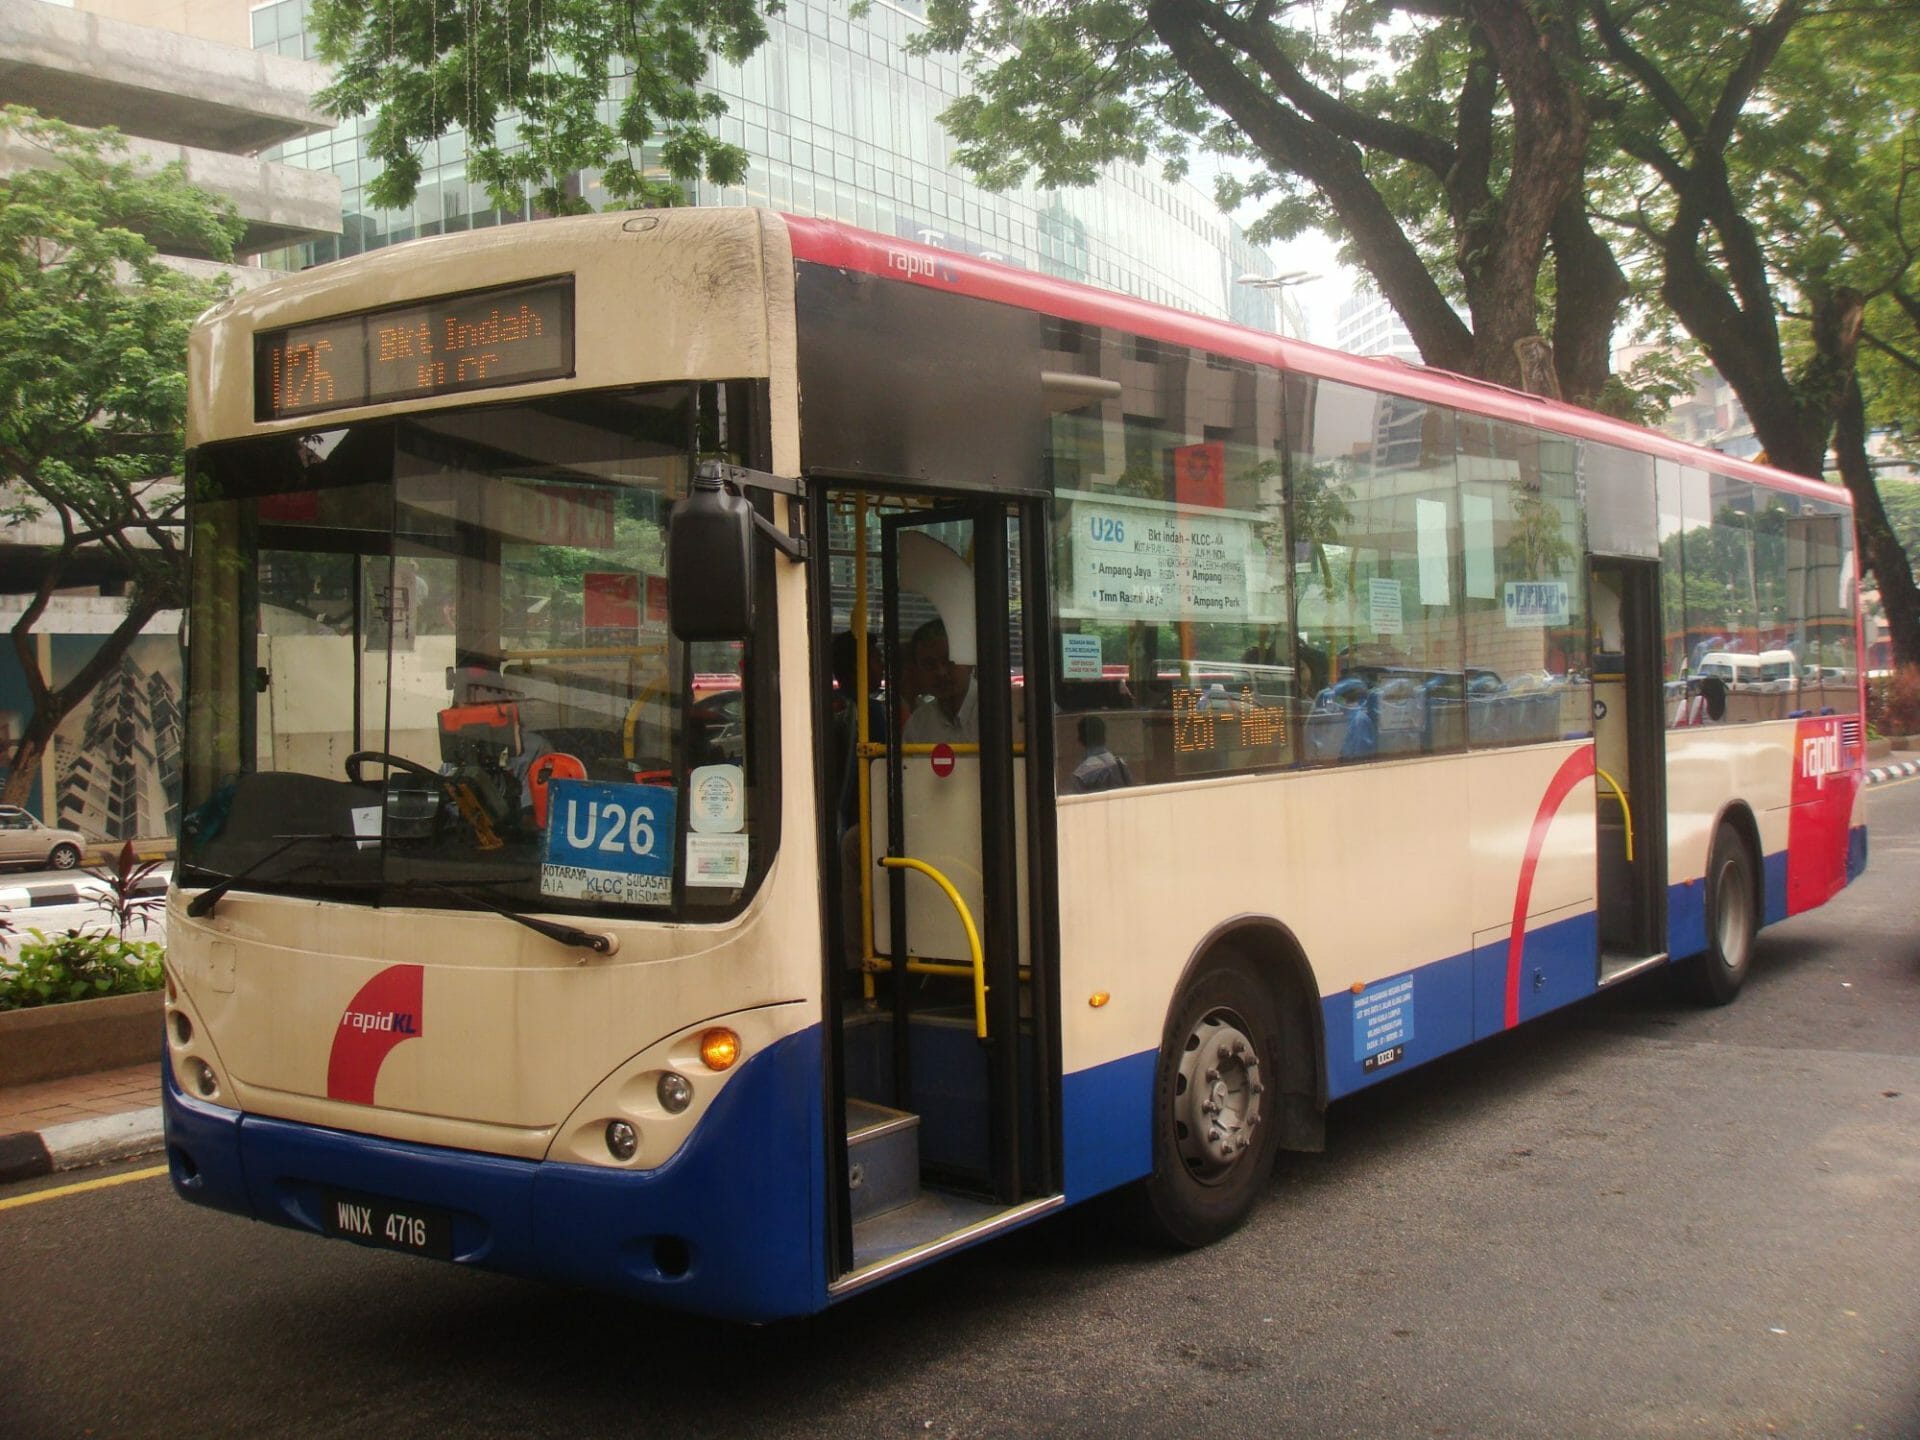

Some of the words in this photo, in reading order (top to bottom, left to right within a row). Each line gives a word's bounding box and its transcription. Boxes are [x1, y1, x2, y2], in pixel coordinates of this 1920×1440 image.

[378, 323, 433, 362] Bkt
[445, 304, 542, 352] Indah
[1090, 516, 1125, 544] U26
[1148, 528, 1161, 542] Bkt
[1191, 533, 1211, 546] KLCC
[1099, 562, 1132, 579] Ampang
[1133, 565, 1152, 579] Jaya
[1192, 569, 1222, 584] Ampang
[1099, 590, 1118, 603] Tmn
[1193, 595, 1223, 609] Ampang
[1224, 596, 1240, 607] Park
[1802, 721, 1839, 791] rapid
[566, 799, 655, 855] U26
[543, 863, 587, 881] KOTARAYA
[586, 877, 622, 895] KLCC
[343, 1009, 417, 1035] rapidKL
[337, 1201, 373, 1236] WNX
[385, 1212, 426, 1246] 4716
